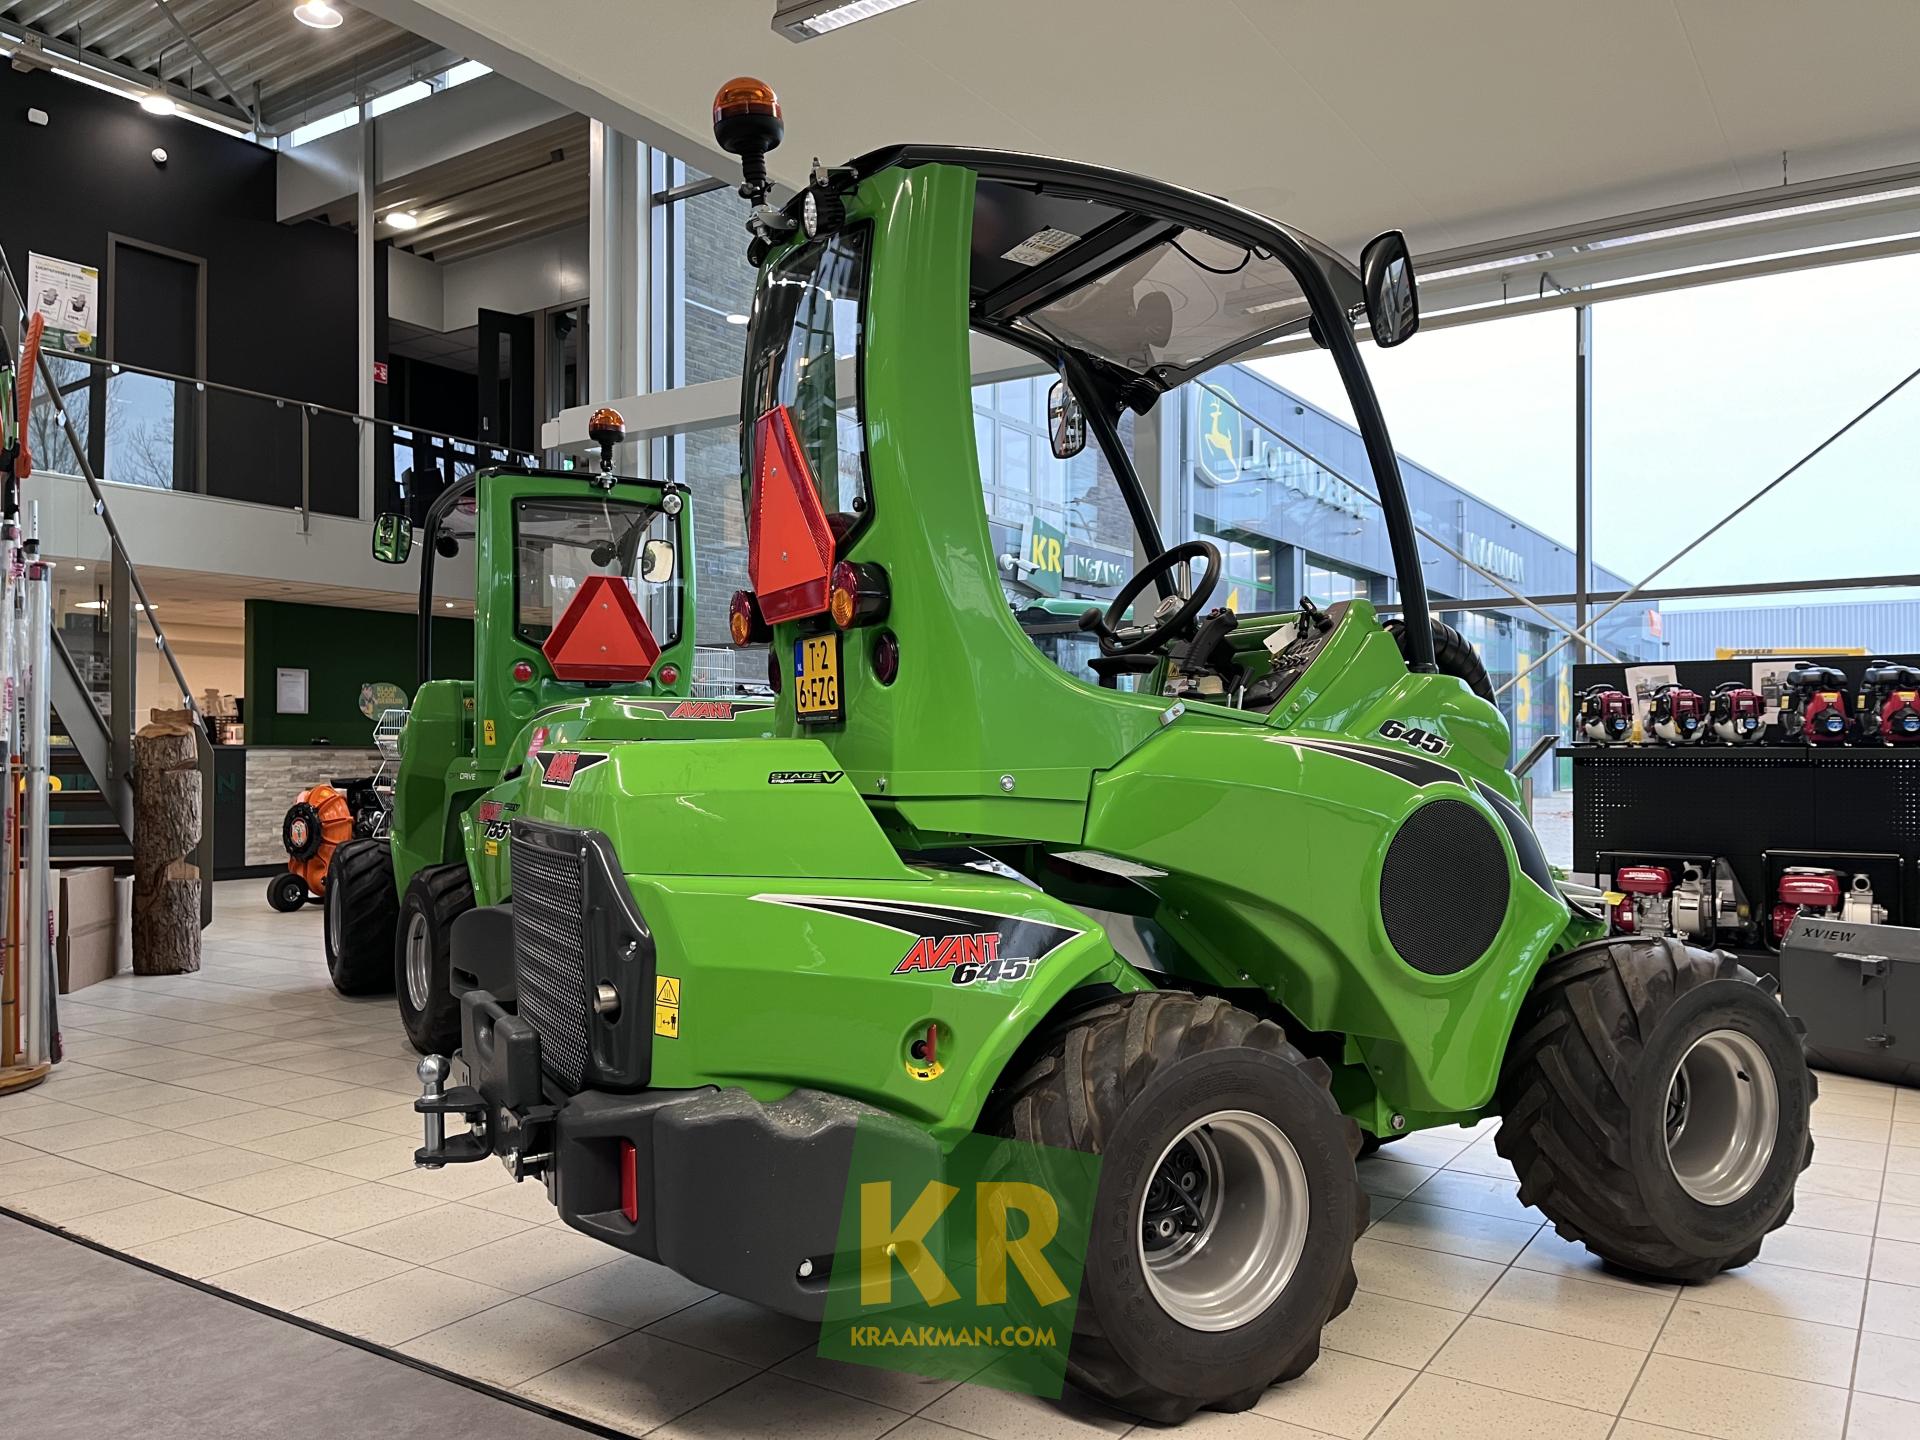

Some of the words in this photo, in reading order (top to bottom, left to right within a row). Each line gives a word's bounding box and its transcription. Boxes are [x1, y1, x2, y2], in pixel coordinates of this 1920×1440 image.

[1032, 534, 1062, 573] KR
[669, 701, 734, 719] AVANT
[459, 772, 476, 781] DRIVE
[822, 771, 842, 783] V
[1802, 927, 1857, 942] XVIEW
[890, 932, 1002, 975] AVANT
